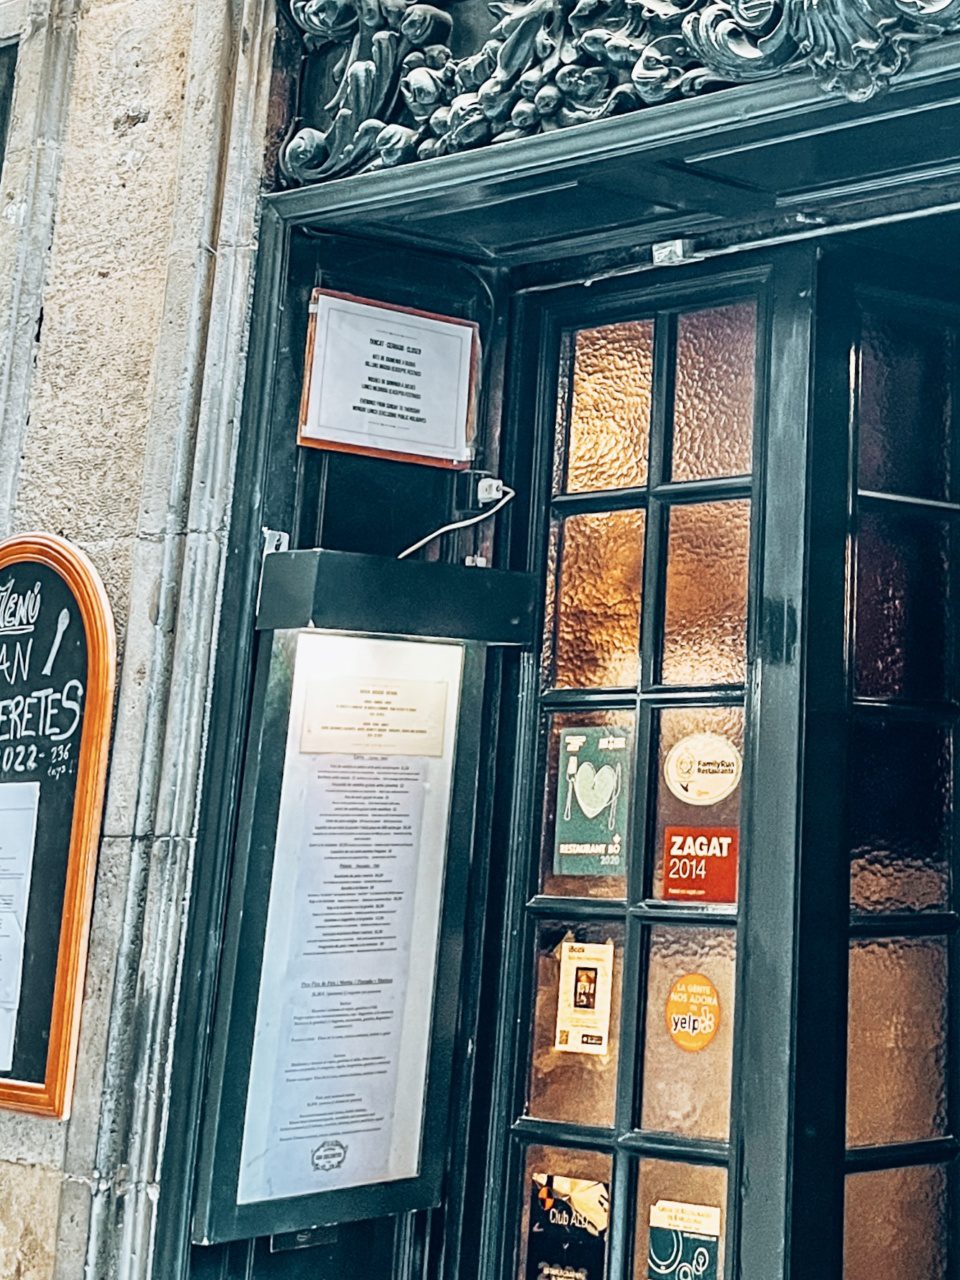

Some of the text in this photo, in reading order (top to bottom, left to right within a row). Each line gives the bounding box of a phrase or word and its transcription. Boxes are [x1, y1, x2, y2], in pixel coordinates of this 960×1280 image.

[670, 835, 732, 857] ZAGAT
[668, 858, 707, 880] 2014
[673, 1015, 699, 1034] yelp
[549, 1208, 569, 1226] Club
